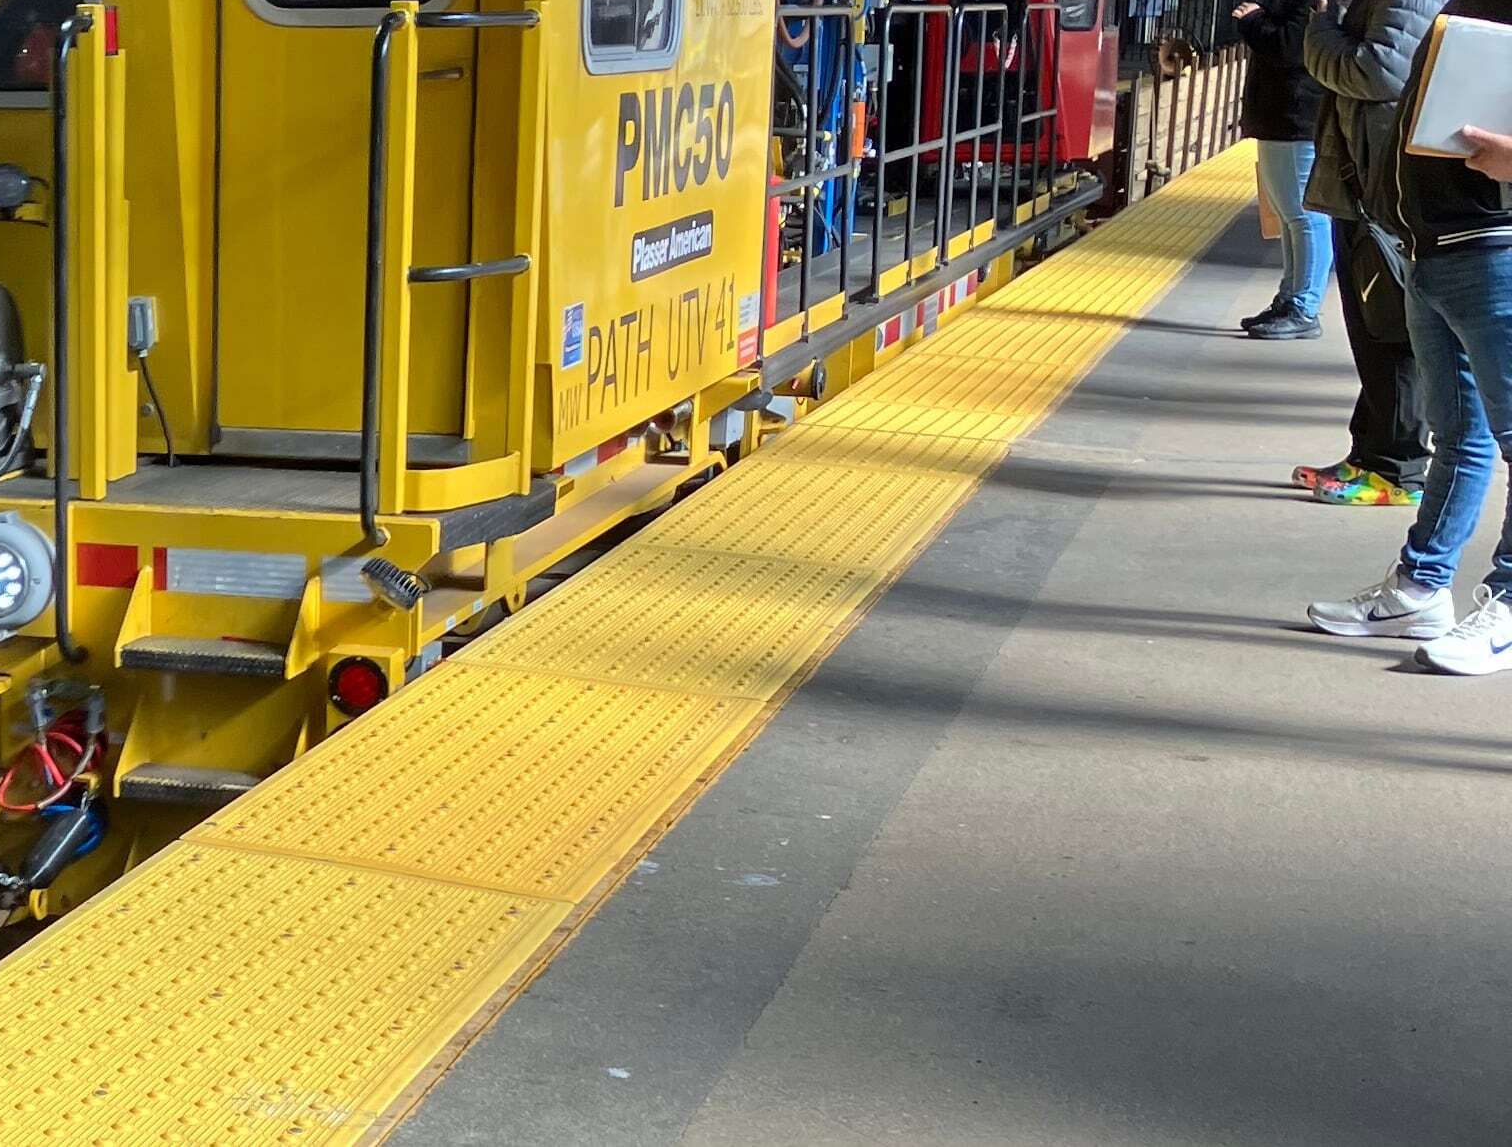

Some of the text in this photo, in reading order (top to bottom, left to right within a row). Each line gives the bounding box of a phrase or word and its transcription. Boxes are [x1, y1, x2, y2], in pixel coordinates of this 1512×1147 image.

[614, 80, 735, 208] PMC50
[632, 220, 713, 274] Plasser American
[586, 304, 654, 421] PATH
[667, 284, 711, 381] UTV
[714, 272, 735, 355] 41
